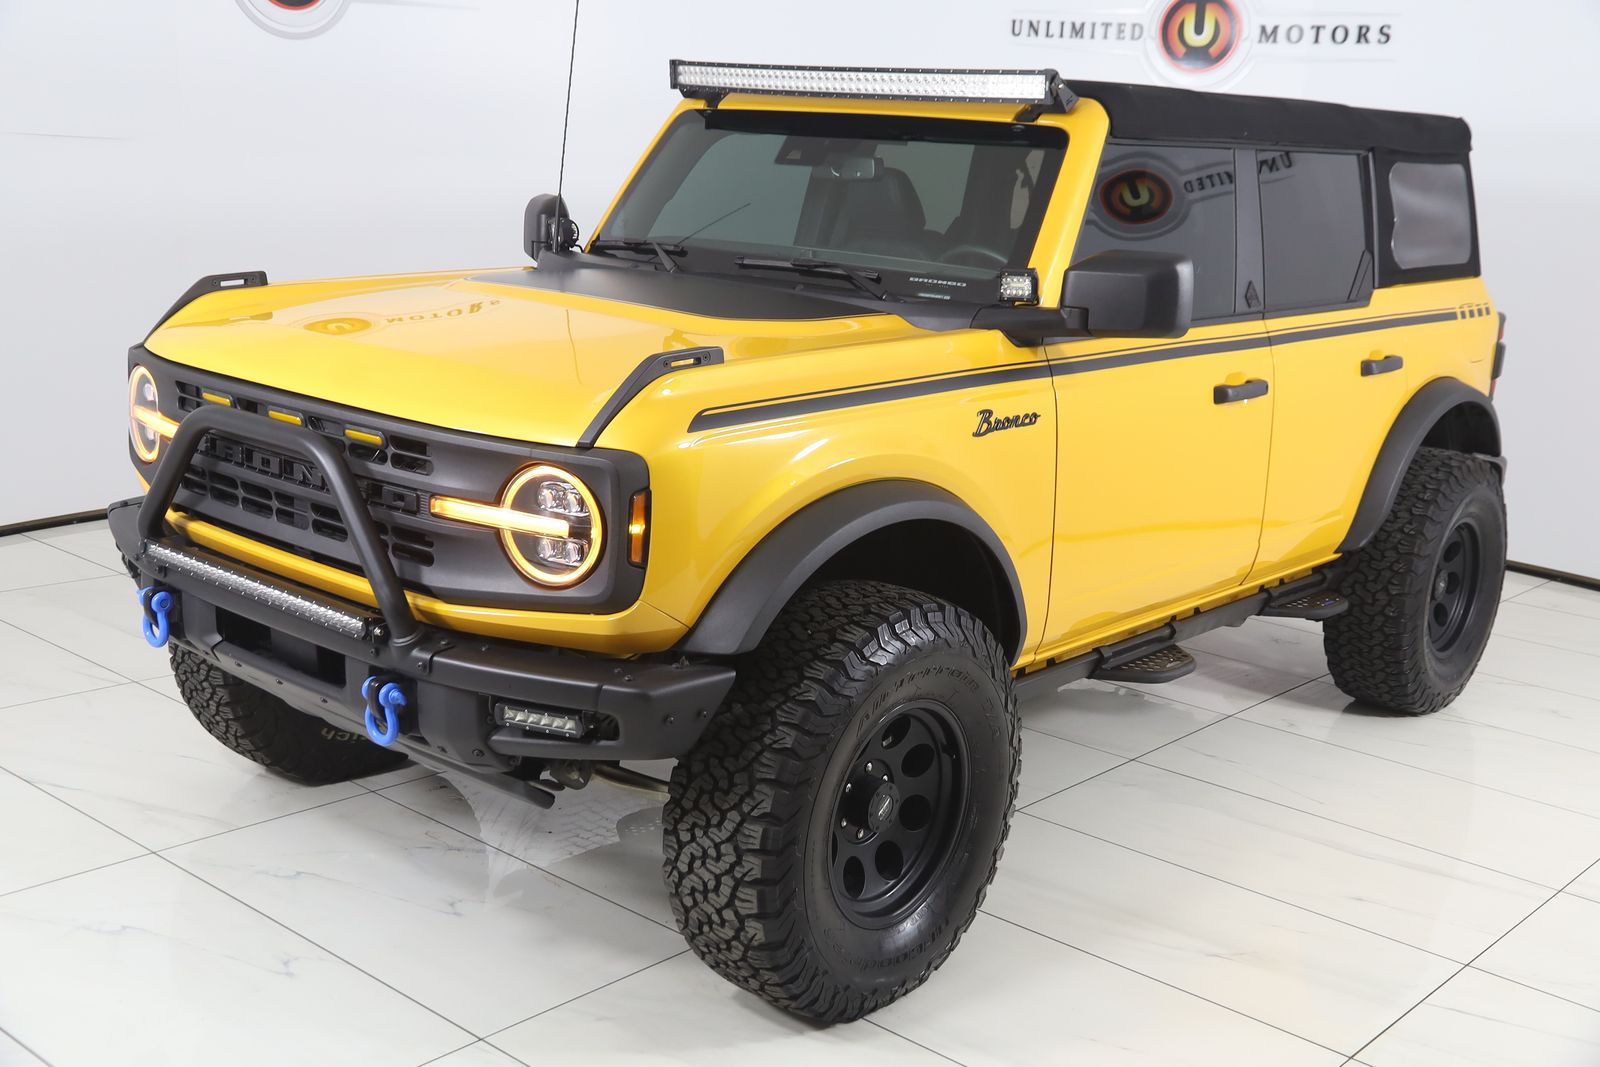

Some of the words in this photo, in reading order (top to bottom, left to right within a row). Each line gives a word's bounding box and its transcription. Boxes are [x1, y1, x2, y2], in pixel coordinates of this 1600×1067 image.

[1010, 19, 1144, 41] UNLIMITED
[1257, 24, 1393, 45] MOTORS
[971, 408, 1042, 438] Bronco
